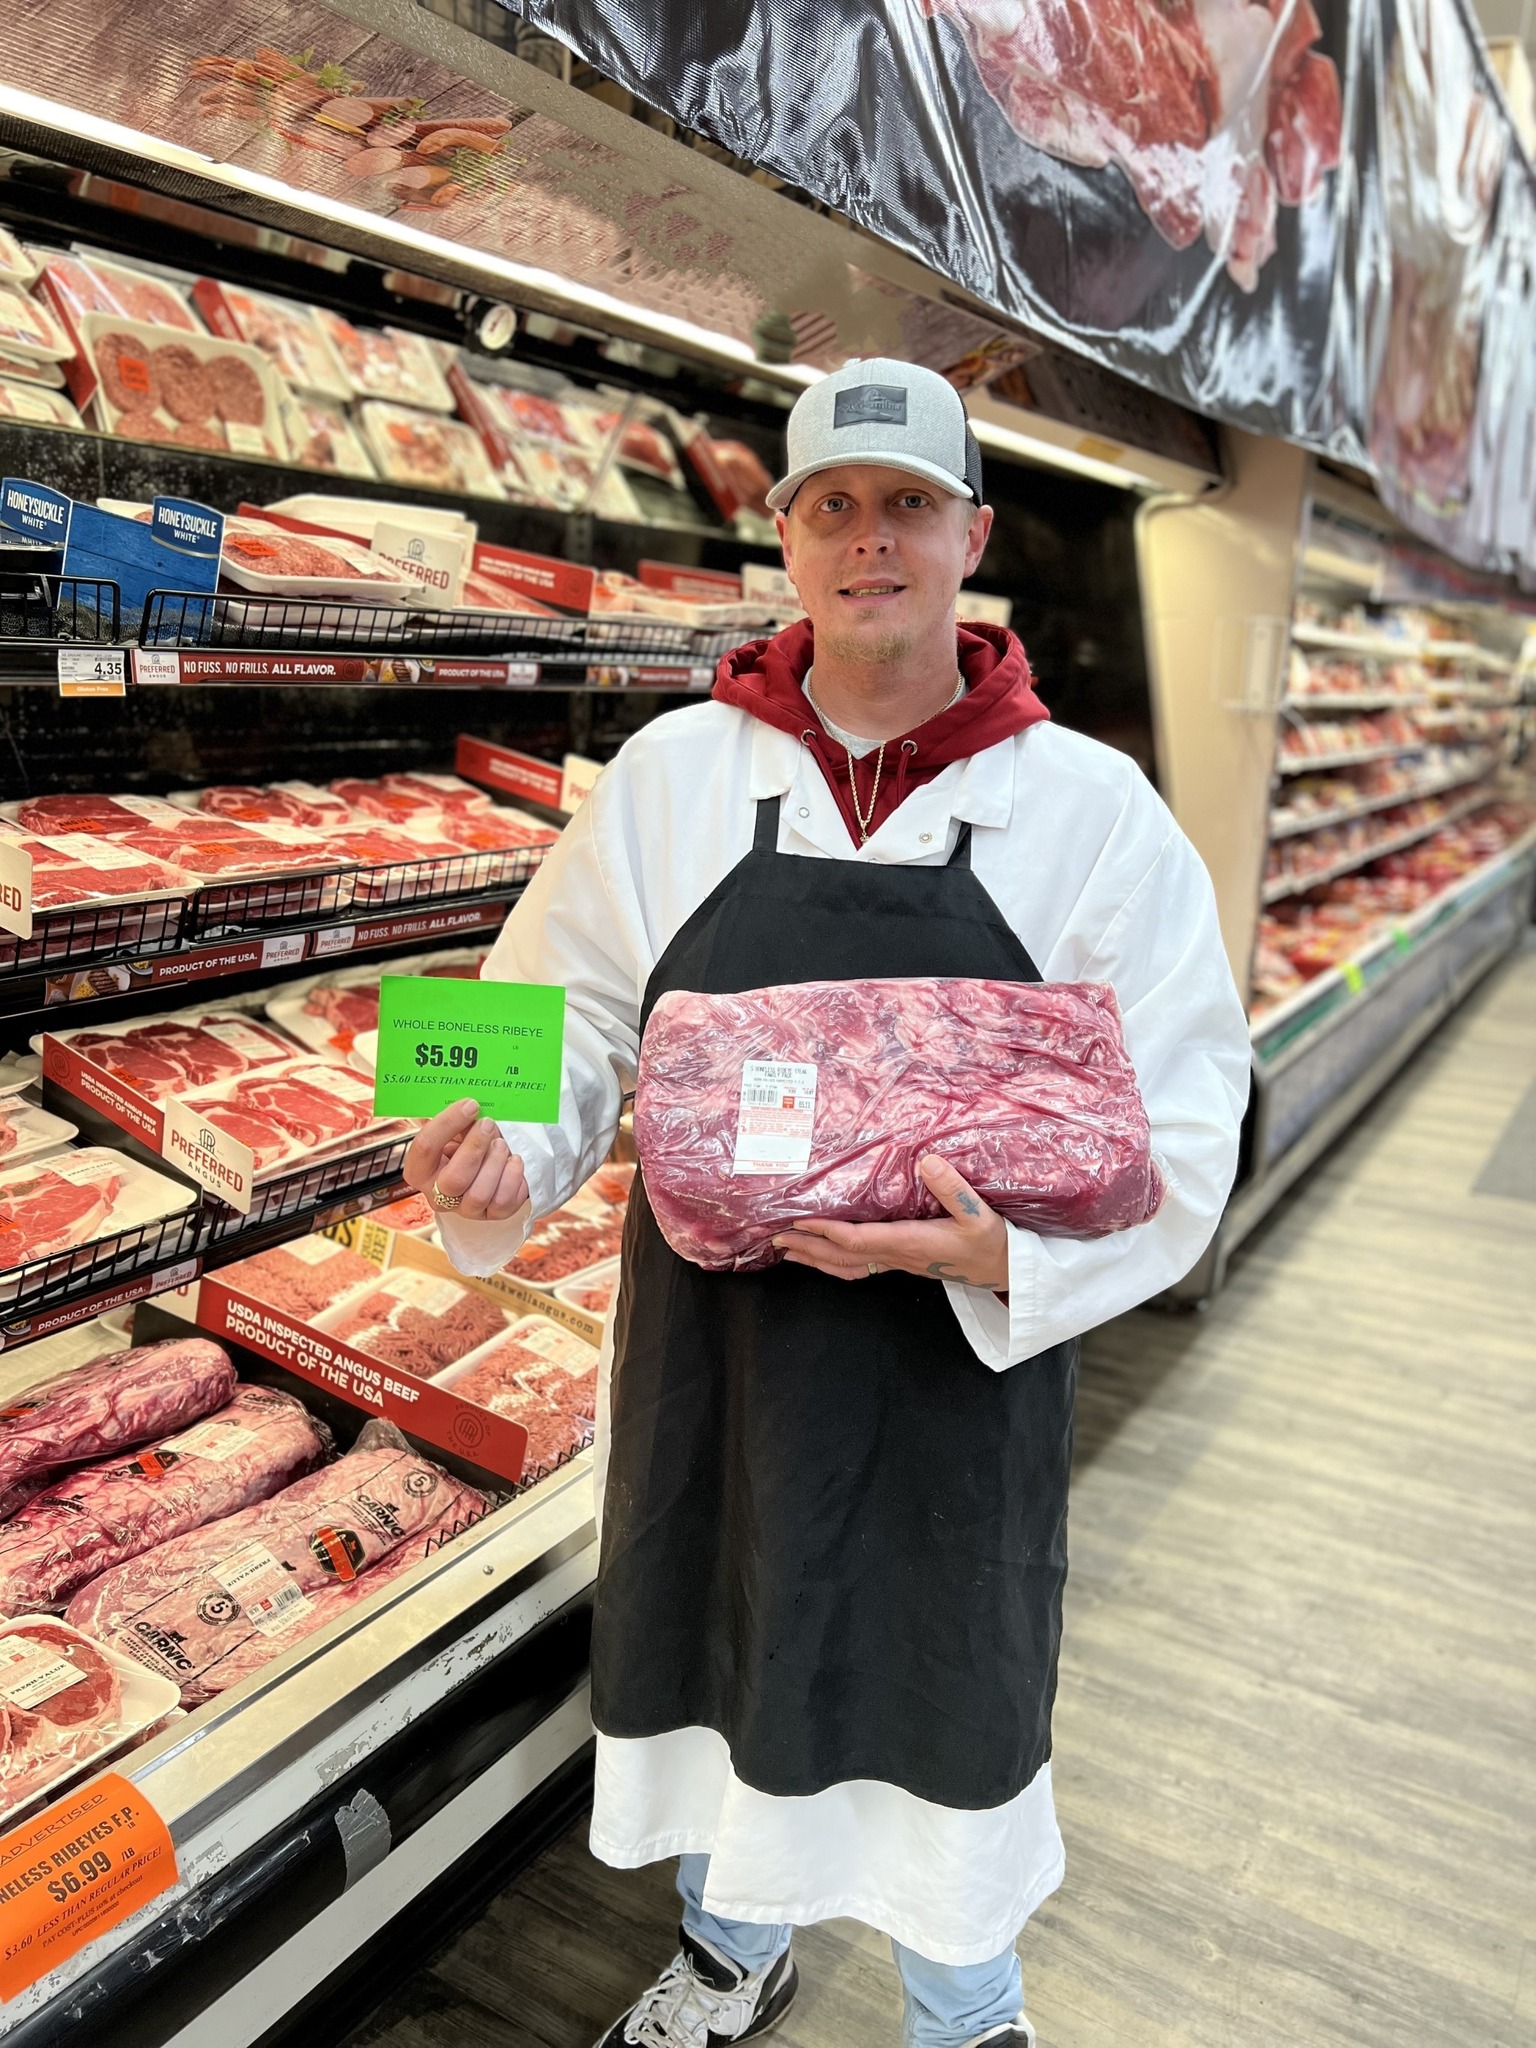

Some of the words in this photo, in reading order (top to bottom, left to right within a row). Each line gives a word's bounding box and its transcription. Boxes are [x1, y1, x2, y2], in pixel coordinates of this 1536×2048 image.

[6, 489, 65, 525] HONEYSUCKLE
[21, 514, 45, 531] WHITE
[158, 506, 218, 539] HONEYSUCKLE
[173, 529, 198, 544] WHITE
[94, 662, 122, 675] 4.35
[139, 664, 176, 674] PREFERRED
[183, 661, 196, 674] NO
[197, 661, 222, 674] FUSS.
[225, 662, 238, 674] NO
[239, 662, 270, 675] FRILLS.
[271, 664, 292, 675] ALL
[293, 664, 336, 676] FLAVOR.
[320, 937, 352, 949] PREFERRED
[357, 930, 369, 942] NO
[369, 927, 390, 940] FUSS.
[391, 925, 403, 936] NO
[402, 921, 427, 934] FRILLS.
[428, 918, 446, 930] ALL
[159, 961, 203, 977] PRODUCT
[205, 959, 218, 969] OF
[218, 956, 237, 966] THE
[237, 952, 258, 963] USA.
[265, 948, 300, 960] PREFERRED
[392, 1019, 435, 1031] WHOLE
[437, 1021, 500, 1035] BONELESS
[502, 1025, 544, 1038] RIBEYE
[415, 1042, 479, 1069] $5.99
[383, 1073, 411, 1085] $5.60
[413, 1075, 438, 1085] LESS
[439, 1076, 466, 1086] THAN
[467, 1078, 513, 1090] REGULAR
[514, 1081, 547, 1092] PRICE!
[505, 1065, 519, 1076] /LB
[81, 1078, 116, 1107] PRODUCT
[115, 1102, 125, 1114] OF
[125, 1109, 141, 1126] THE
[141, 1120, 157, 1137] USA
[171, 1128, 243, 1193] PREFERRED
[187, 1161, 222, 1189] ANGUS
[154, 1270, 192, 1289] PREFERRED
[37, 1306, 89, 1332] PRODUCT
[88, 1301, 103, 1312] OF
[103, 1294, 123, 1306] THE
[124, 1286, 146, 1299] USA.
[225, 1314, 296, 1360] PRODUCT
[296, 1351, 318, 1371] OF
[319, 1361, 350, 1390] THE
[352, 1379, 385, 1408] USA
[227, 1299, 262, 1327] USDA
[263, 1316, 333, 1362] INSPECTED
[333, 1354, 382, 1387] ANGUS
[383, 1377, 420, 1403] BEEF
[0, 1794, 103, 1865] ADVERTISED
[0, 1861, 53, 1905] NELESS
[50, 1820, 114, 1868] RIBEYES
[110, 1806, 140, 1828] F.P.
[47, 1850, 112, 1904] $6.99
[121, 1847, 136, 1863] /LB
[4, 1934, 33, 1961] $3.60
[37, 1916, 60, 1938] LESS
[62, 1896, 87, 1920] THAN
[89, 1867, 131, 1902] REGULAR
[132, 1846, 162, 1872] PRICE!
[42, 1933, 57, 1948] PAY
[57, 1907, 96, 1937] COST-PLUS
[95, 1898, 109, 1911] 10%
[109, 1894, 117, 1902] at
[116, 1875, 144, 1897] checkout
